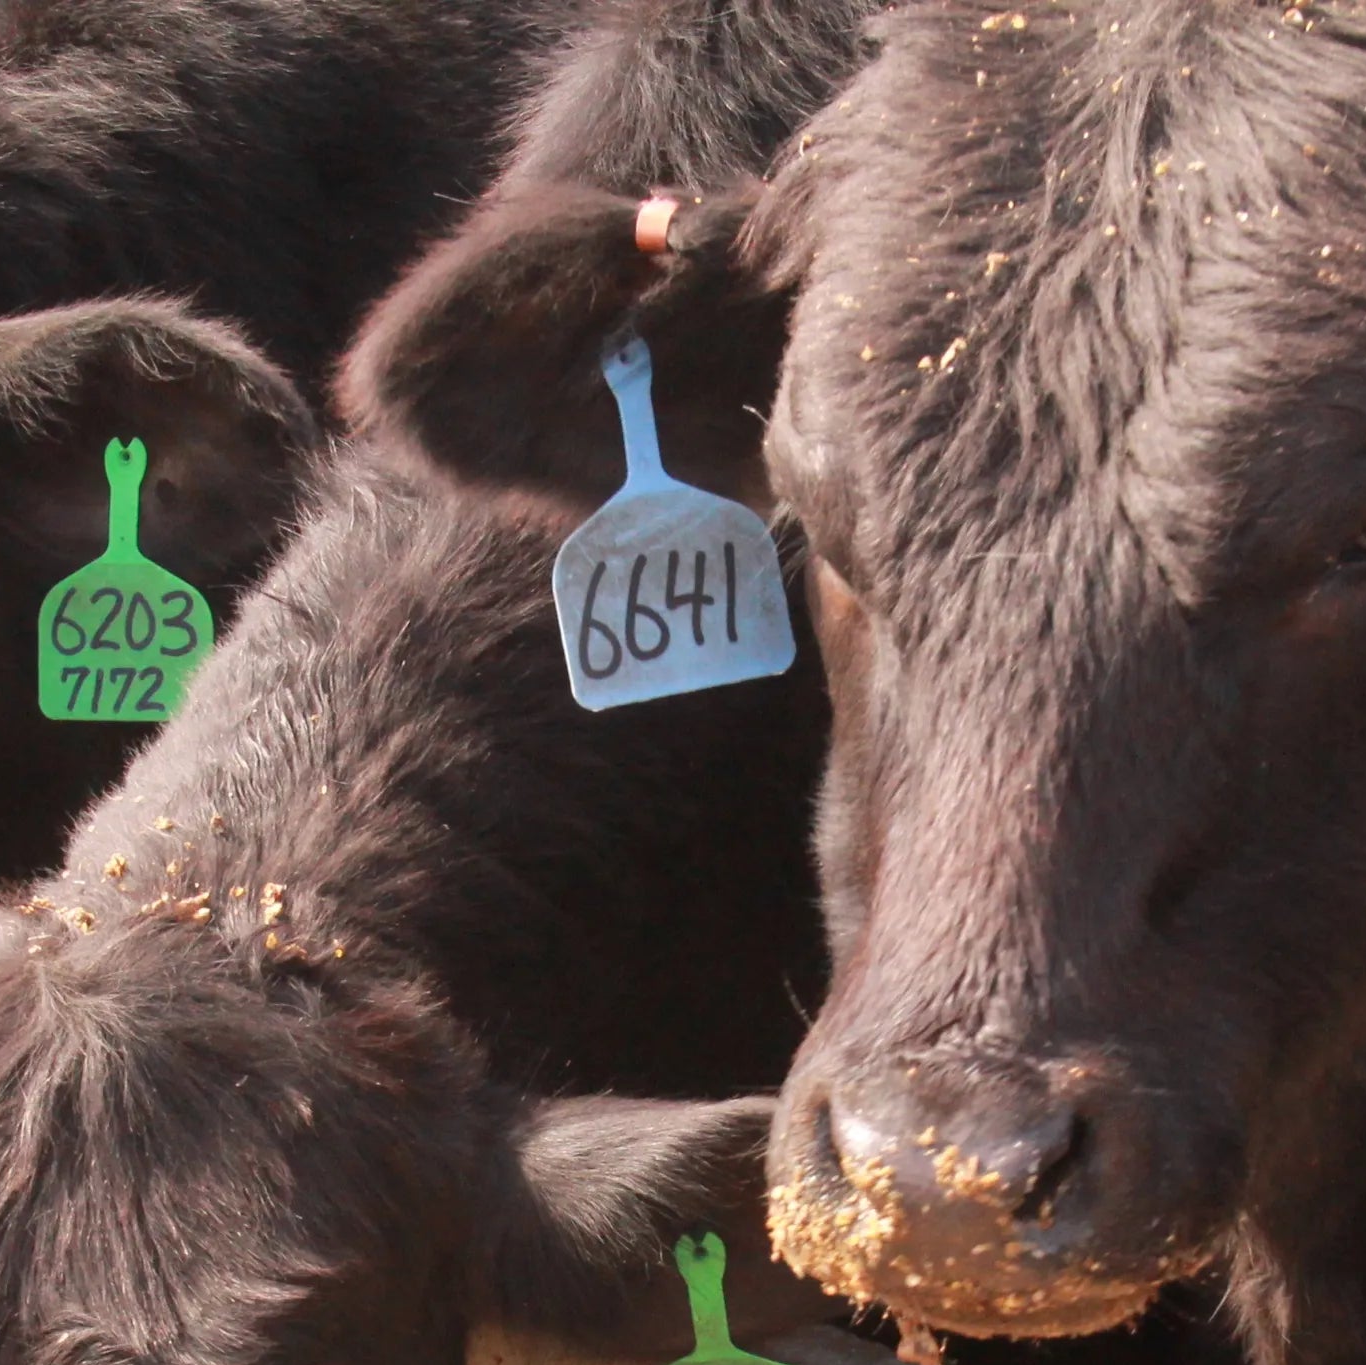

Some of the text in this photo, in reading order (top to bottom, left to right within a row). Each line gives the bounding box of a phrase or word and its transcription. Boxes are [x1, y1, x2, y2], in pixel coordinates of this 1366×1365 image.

[50, 587, 197, 656] 6203
[574, 539, 739, 683] 6641
[58, 665, 164, 712] 7172
